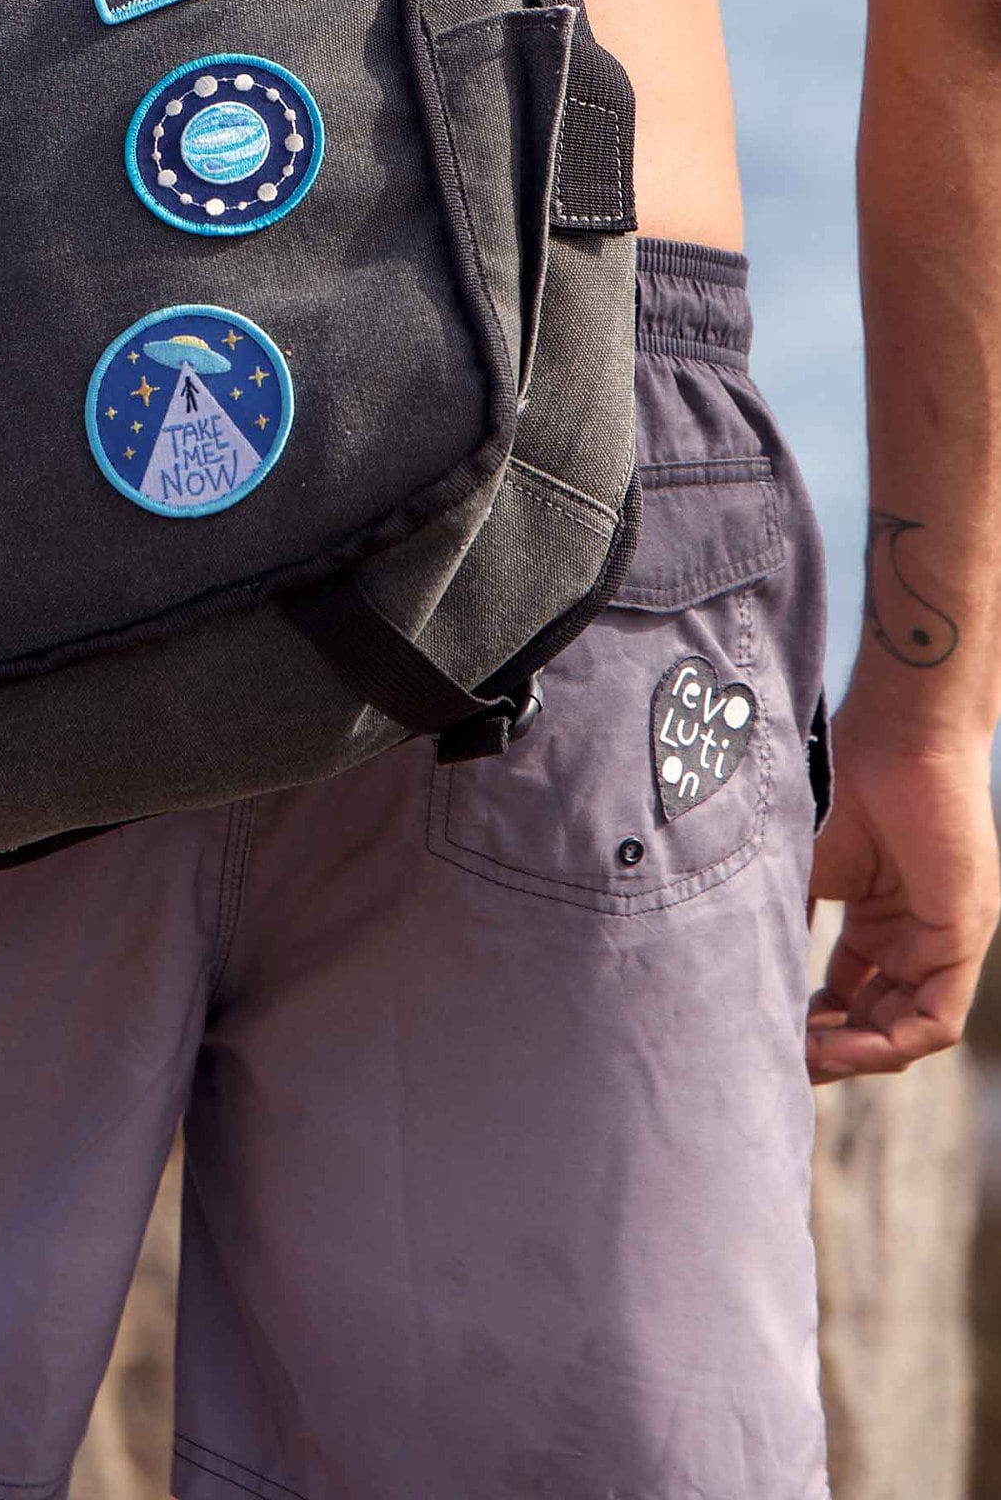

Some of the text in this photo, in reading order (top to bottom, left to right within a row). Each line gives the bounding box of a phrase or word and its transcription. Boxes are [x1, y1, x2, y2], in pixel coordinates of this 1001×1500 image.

[162, 414, 230, 458] TAKE
[183, 442, 224, 471] ME
[161, 449, 238, 499] NOW
